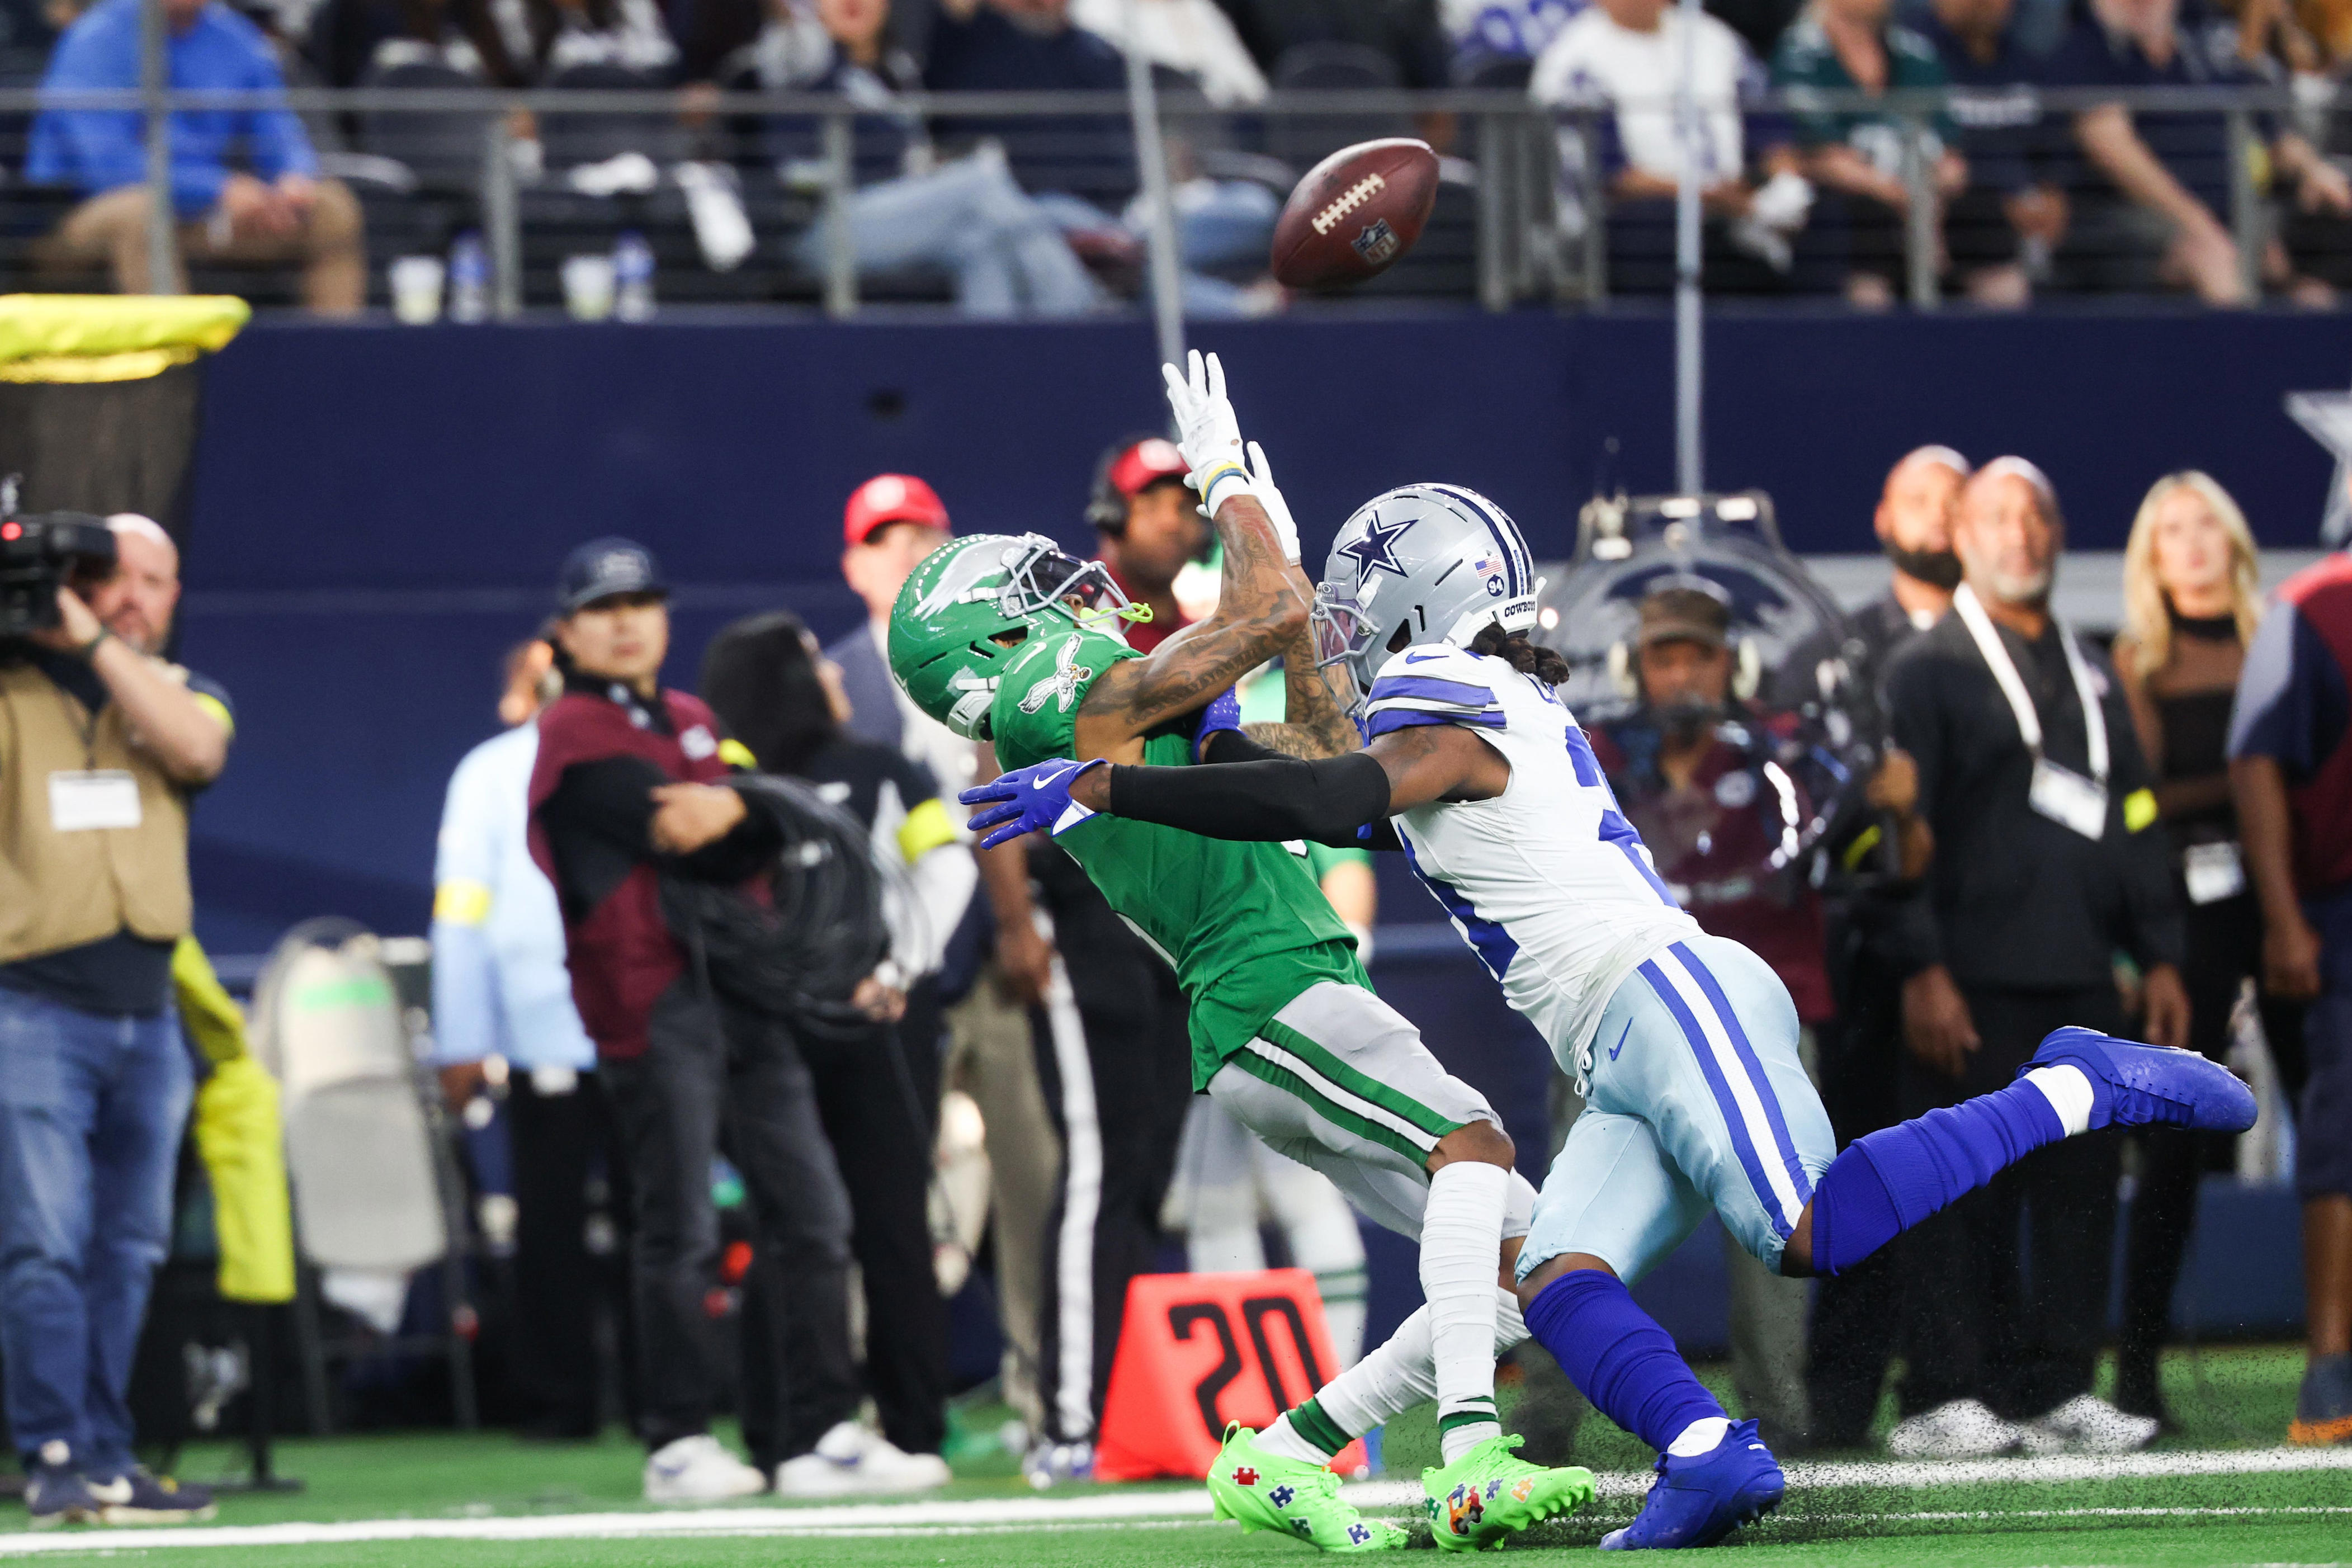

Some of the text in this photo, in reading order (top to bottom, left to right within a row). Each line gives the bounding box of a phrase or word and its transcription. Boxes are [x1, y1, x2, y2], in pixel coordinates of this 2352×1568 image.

[1364, 234, 1398, 261] NFL
[1488, 578, 1504, 594] 94
[1168, 1297, 1325, 1443] 20
